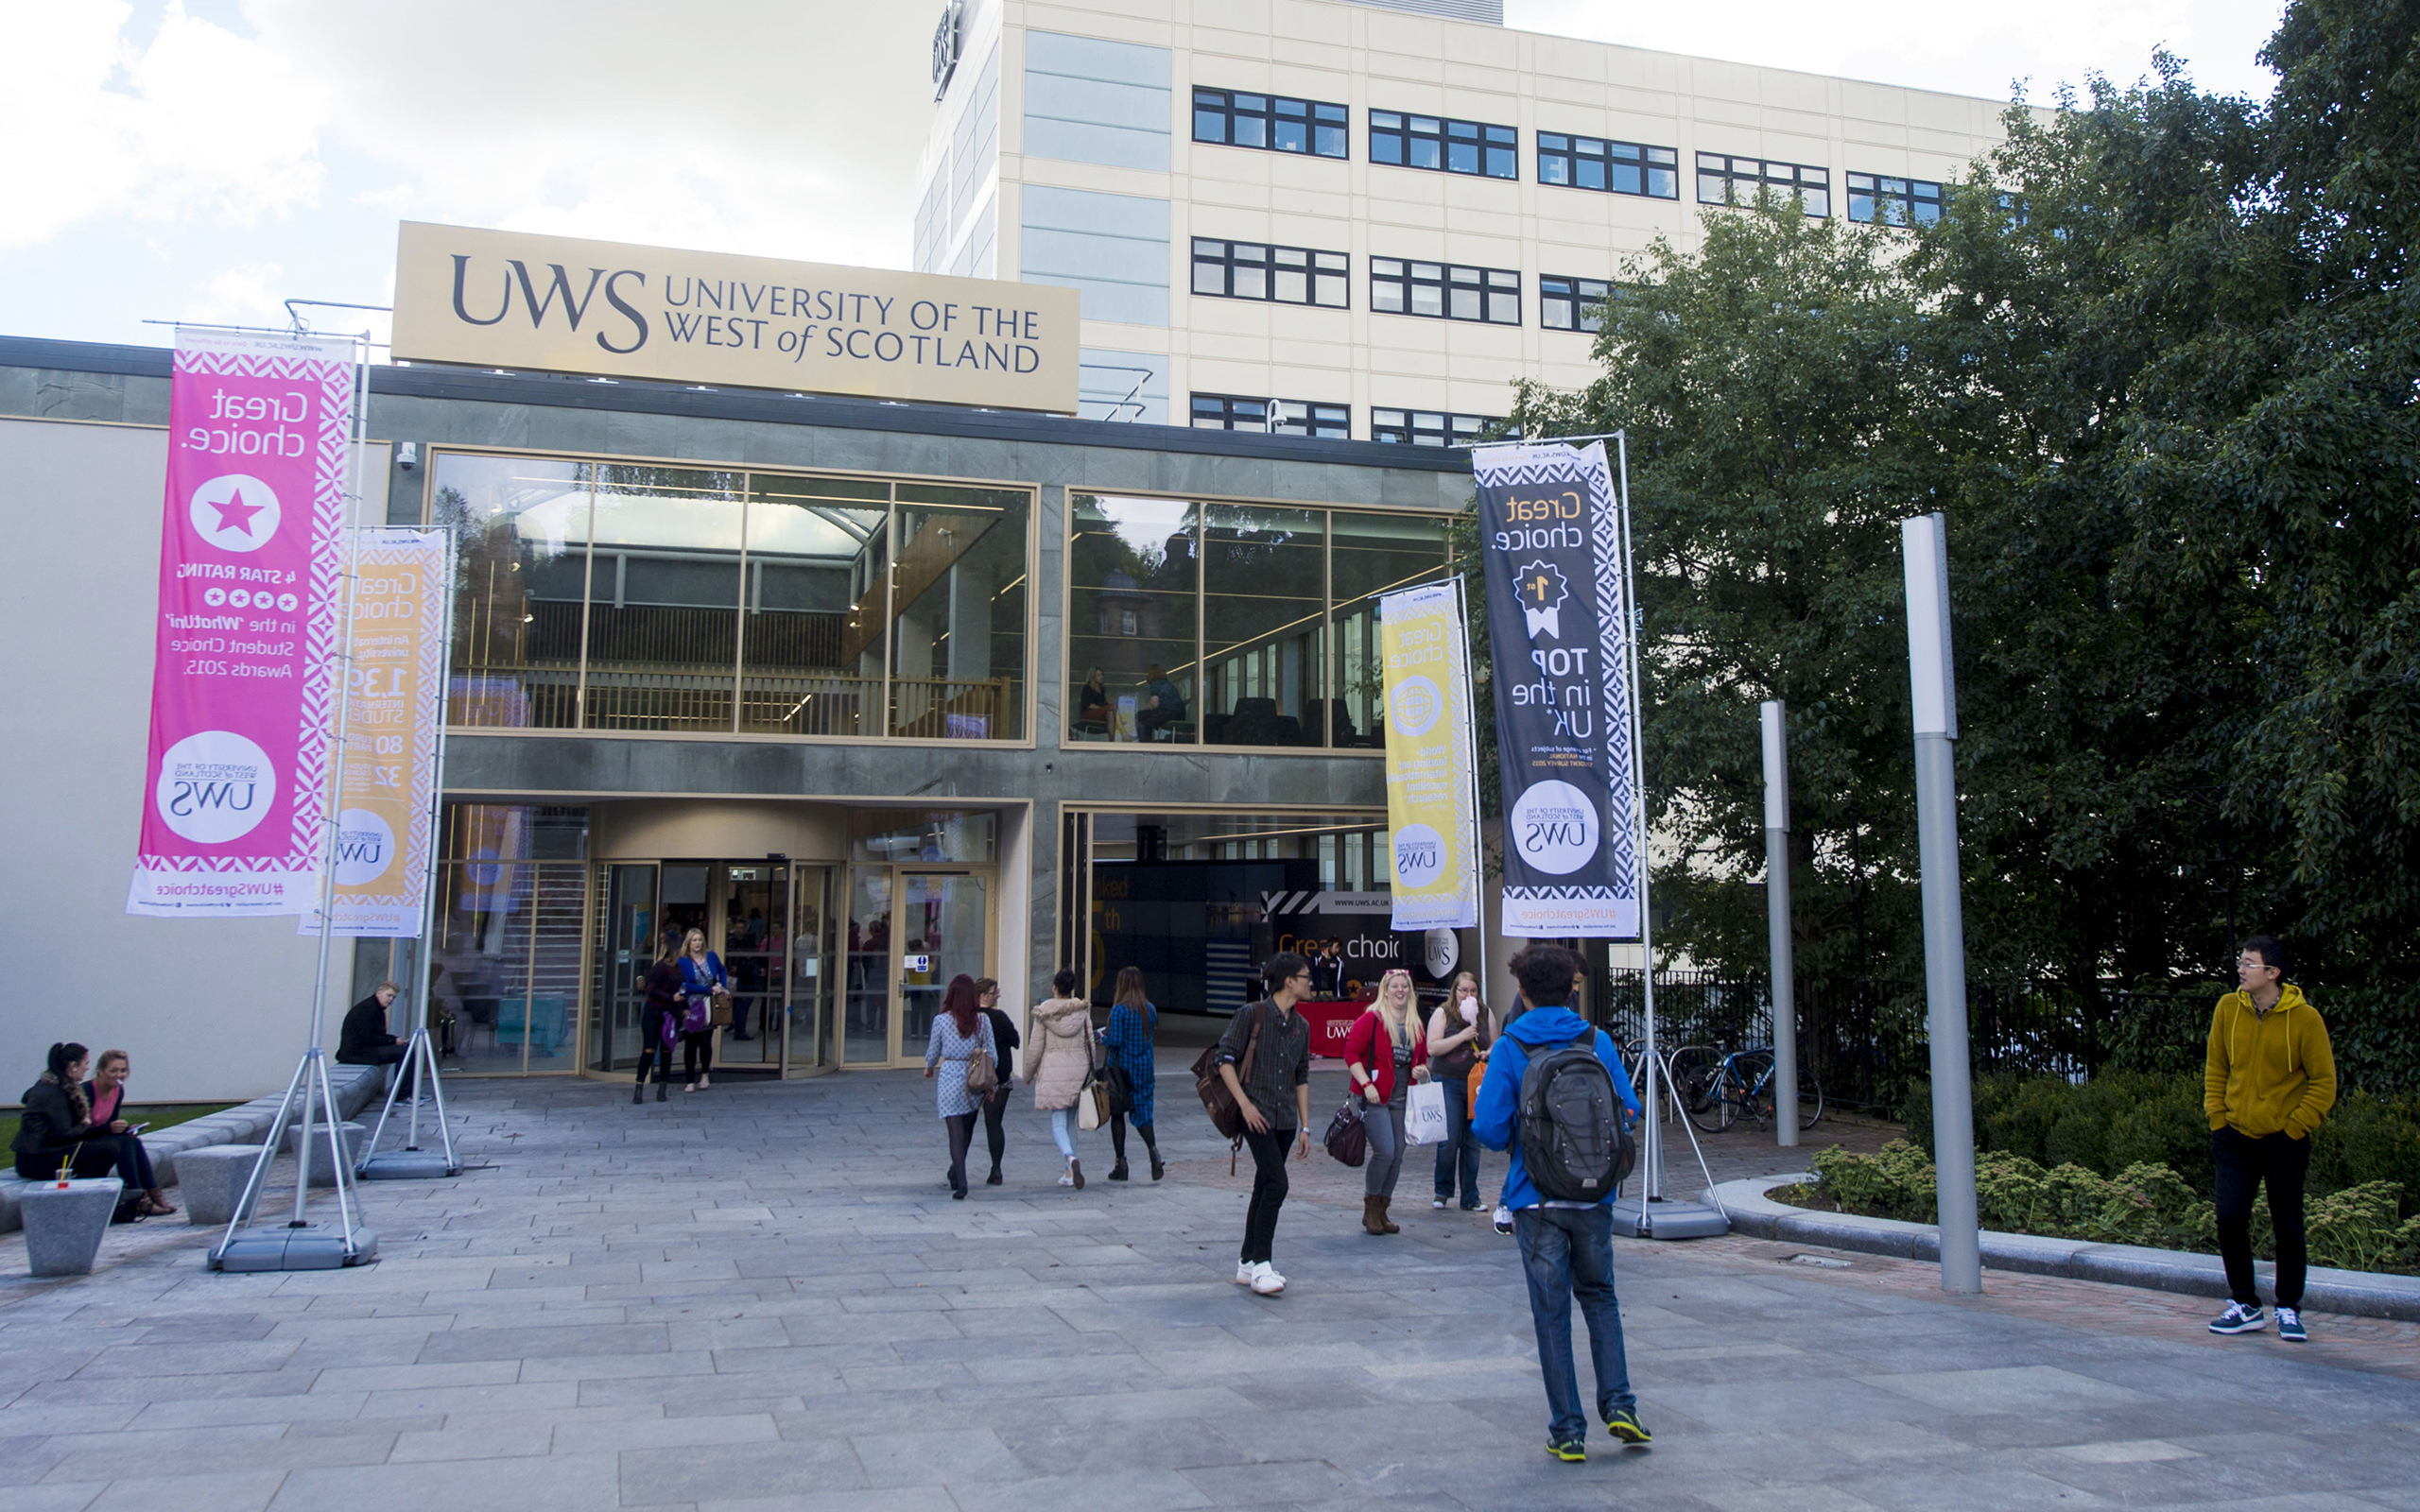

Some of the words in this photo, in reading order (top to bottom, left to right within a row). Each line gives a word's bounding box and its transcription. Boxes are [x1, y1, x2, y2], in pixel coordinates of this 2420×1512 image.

[450, 253, 648, 353] UWS
[664, 274, 896, 326] UNIVERSITY
[909, 301, 959, 332] OF
[971, 306, 1040, 340] THE
[664, 311, 769, 350] WEST
[776, 325, 817, 364] of
[827, 327, 1040, 374] SCOTLAND
[1428, 946, 1450, 965] UWS
[1422, 1109, 1443, 1123] UWS
